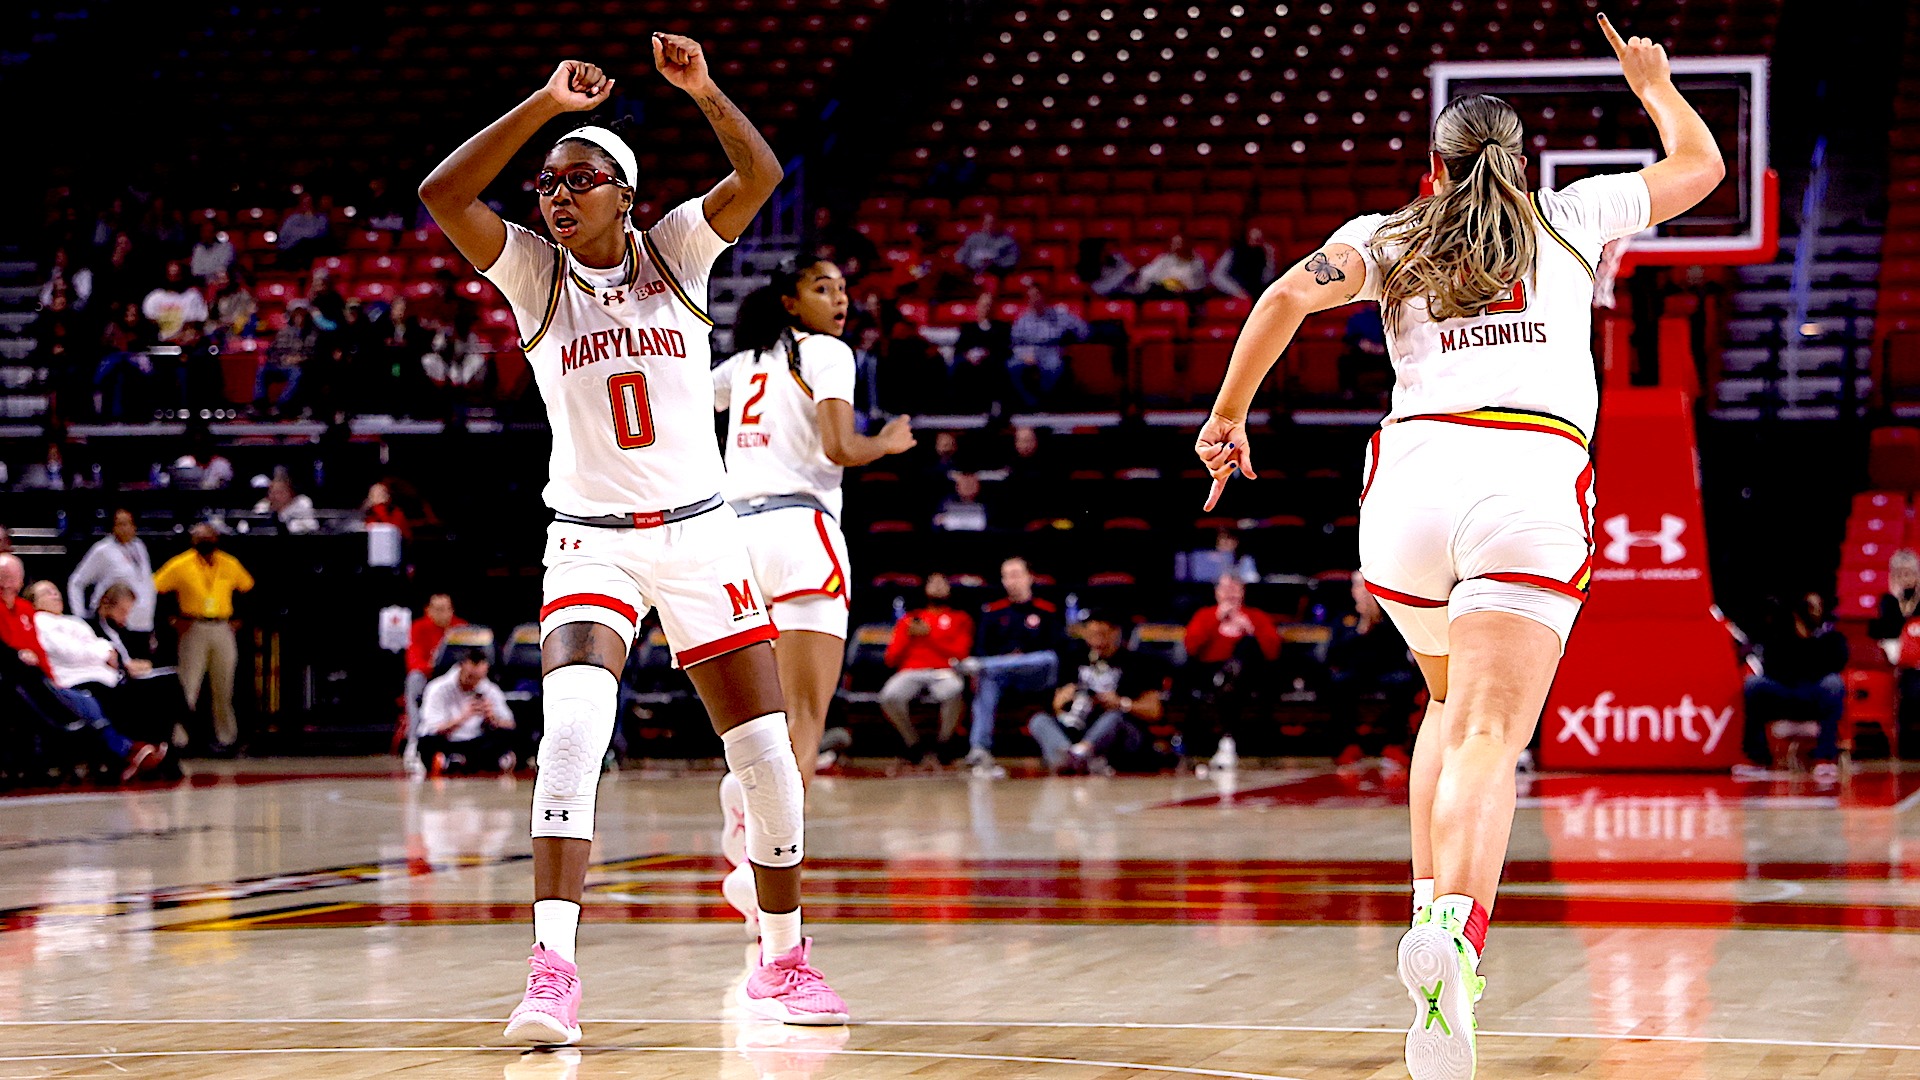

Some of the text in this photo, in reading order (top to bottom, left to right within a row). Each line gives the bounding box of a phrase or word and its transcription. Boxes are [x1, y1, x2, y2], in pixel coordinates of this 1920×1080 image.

[561, 327, 687, 376] MARYLAND
[1440, 322, 1547, 353] MASONIUS
[607, 370, 656, 450] 0
[740, 372, 769, 426] 2
[723, 579, 758, 617] M
[1556, 690, 1735, 756] xfinity
